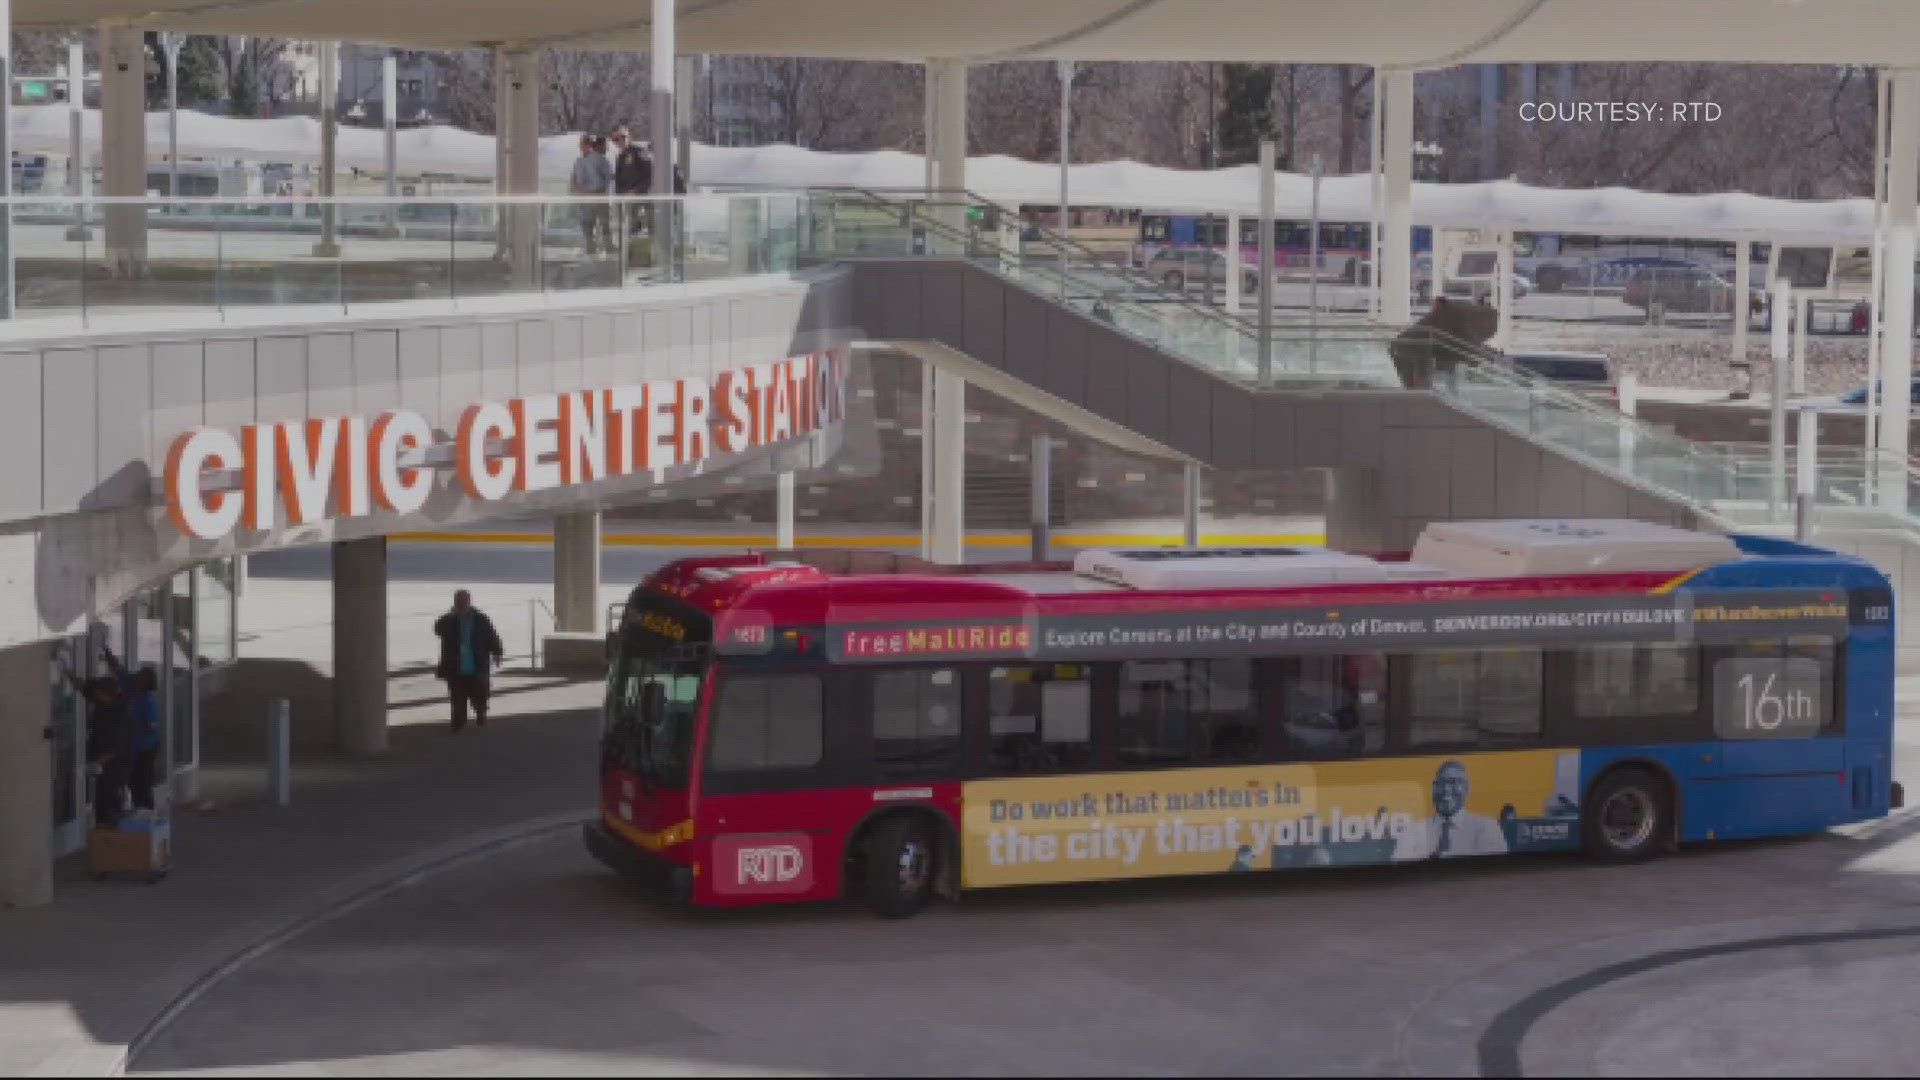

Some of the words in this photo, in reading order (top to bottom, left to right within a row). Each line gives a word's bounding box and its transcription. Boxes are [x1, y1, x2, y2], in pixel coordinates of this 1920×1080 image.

[164, 409, 433, 540] CIVIC
[456, 374, 711, 500] CENTER
[715, 348, 850, 453] STATION
[1196, 624, 1221, 641] the
[1225, 622, 1256, 643] City
[1293, 621, 1347, 640] County
[1351, 618, 1366, 635] of
[1738, 673, 1811, 730] 16th
[990, 799, 1023, 823] Do
[1031, 792, 1098, 818] work
[1103, 791, 1159, 814] that
[1165, 785, 1269, 811] matters
[1275, 781, 1300, 803] in
[986, 826, 1058, 865] the
[1067, 819, 1146, 864] city
[1153, 813, 1239, 854] that
[1251, 811, 1322, 856] you
[1331, 806, 1413, 843] love
[737, 844, 803, 885] RTD
